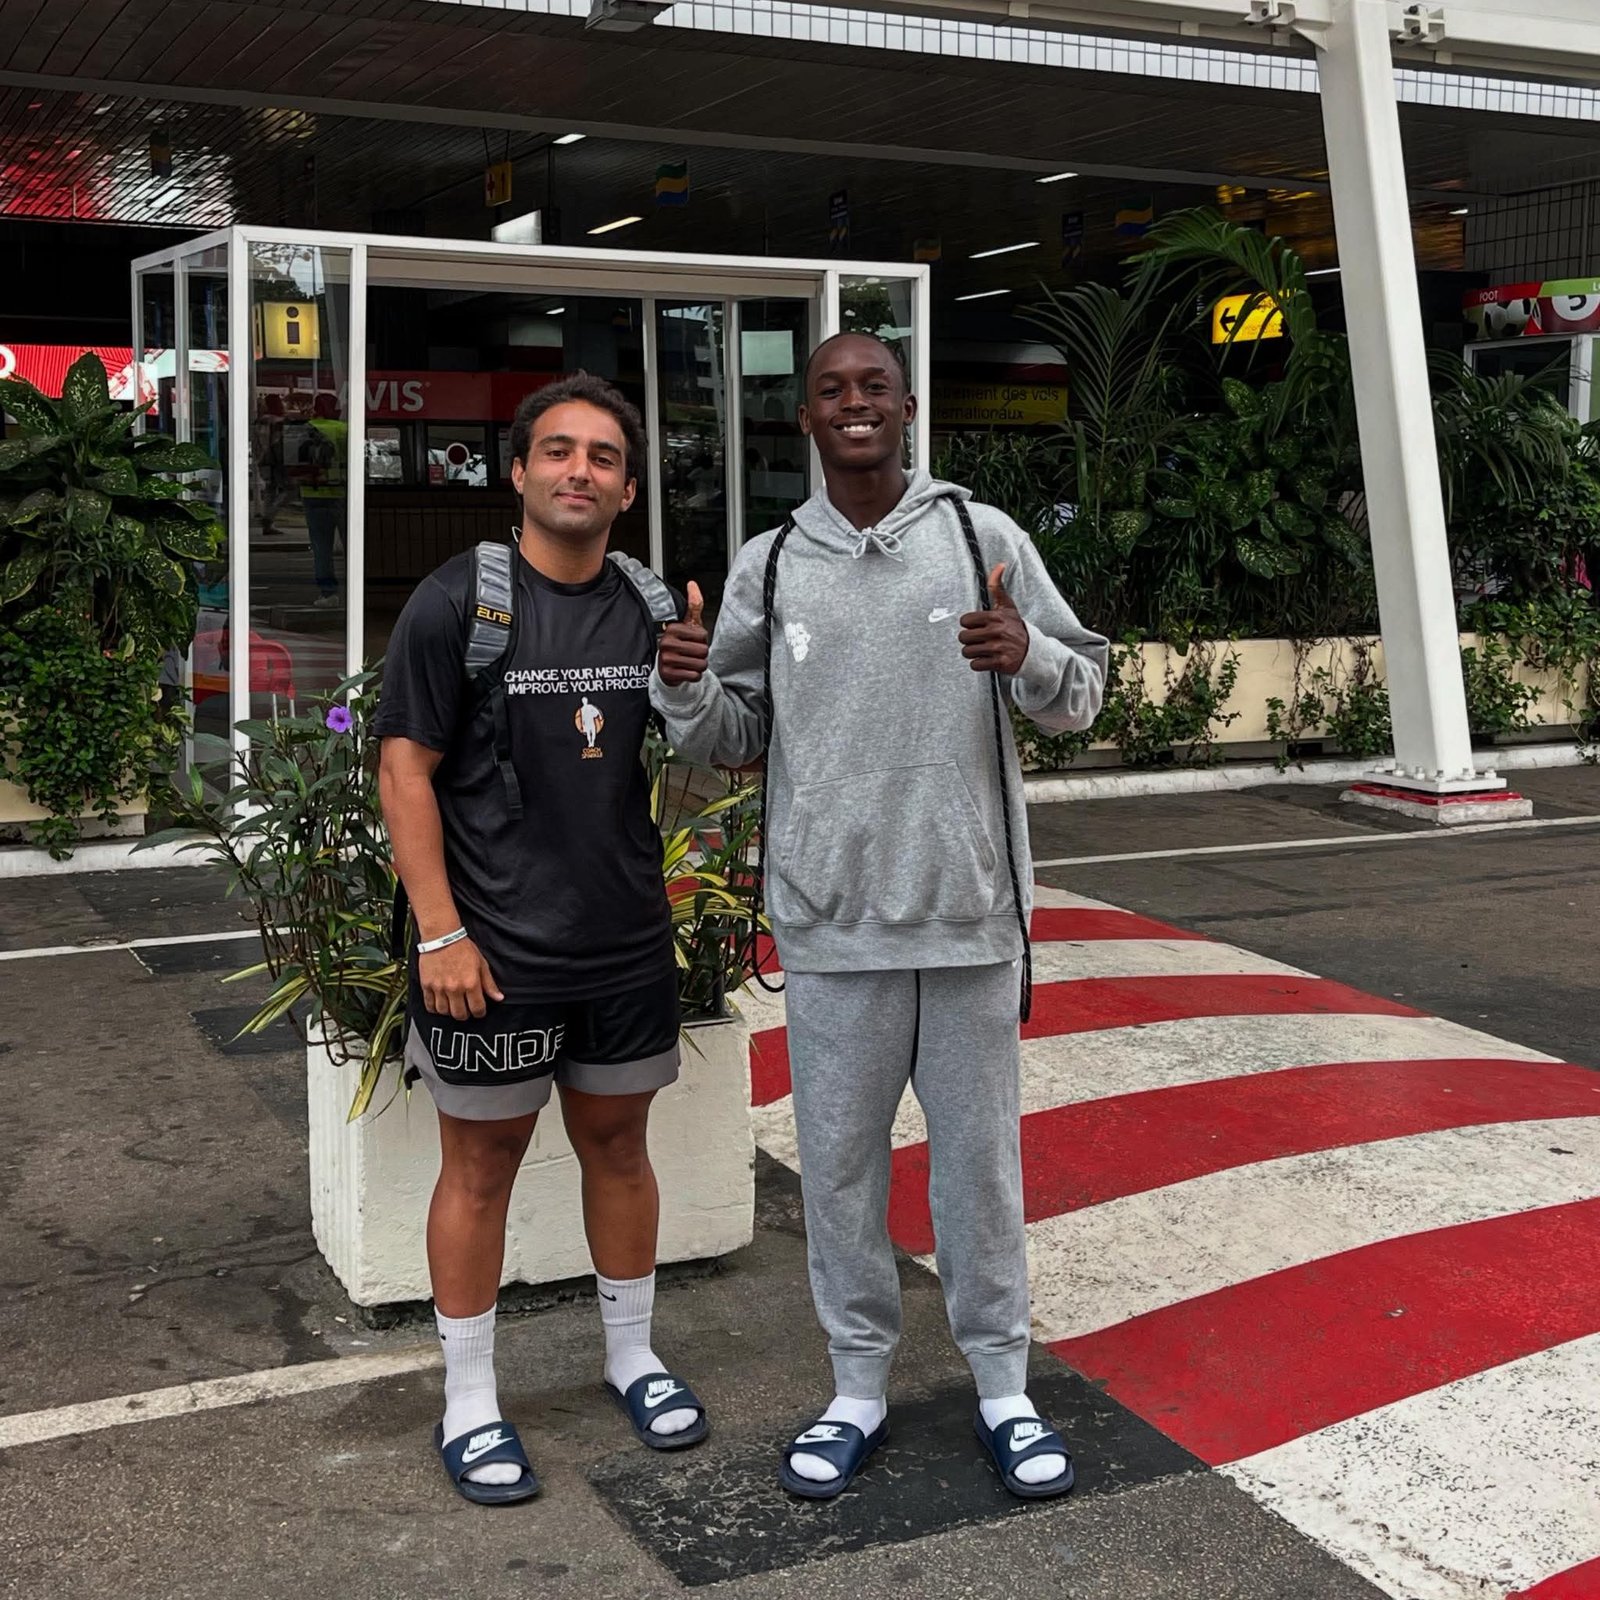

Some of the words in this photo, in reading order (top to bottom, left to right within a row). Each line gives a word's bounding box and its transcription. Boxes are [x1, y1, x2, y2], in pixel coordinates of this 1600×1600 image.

[1479, 290, 1499, 302] FOOT
[477, 606, 512, 625] ELITE
[504, 669, 559, 683] CHANGE
[560, 668, 593, 680] YOUR
[508, 681, 569, 695] IMPROVE
[570, 680, 604, 693] YOUR
[648, 1379, 675, 1397] NIKE
[468, 1428, 502, 1452] NIKE
[1014, 1422, 1043, 1440] NIKE
